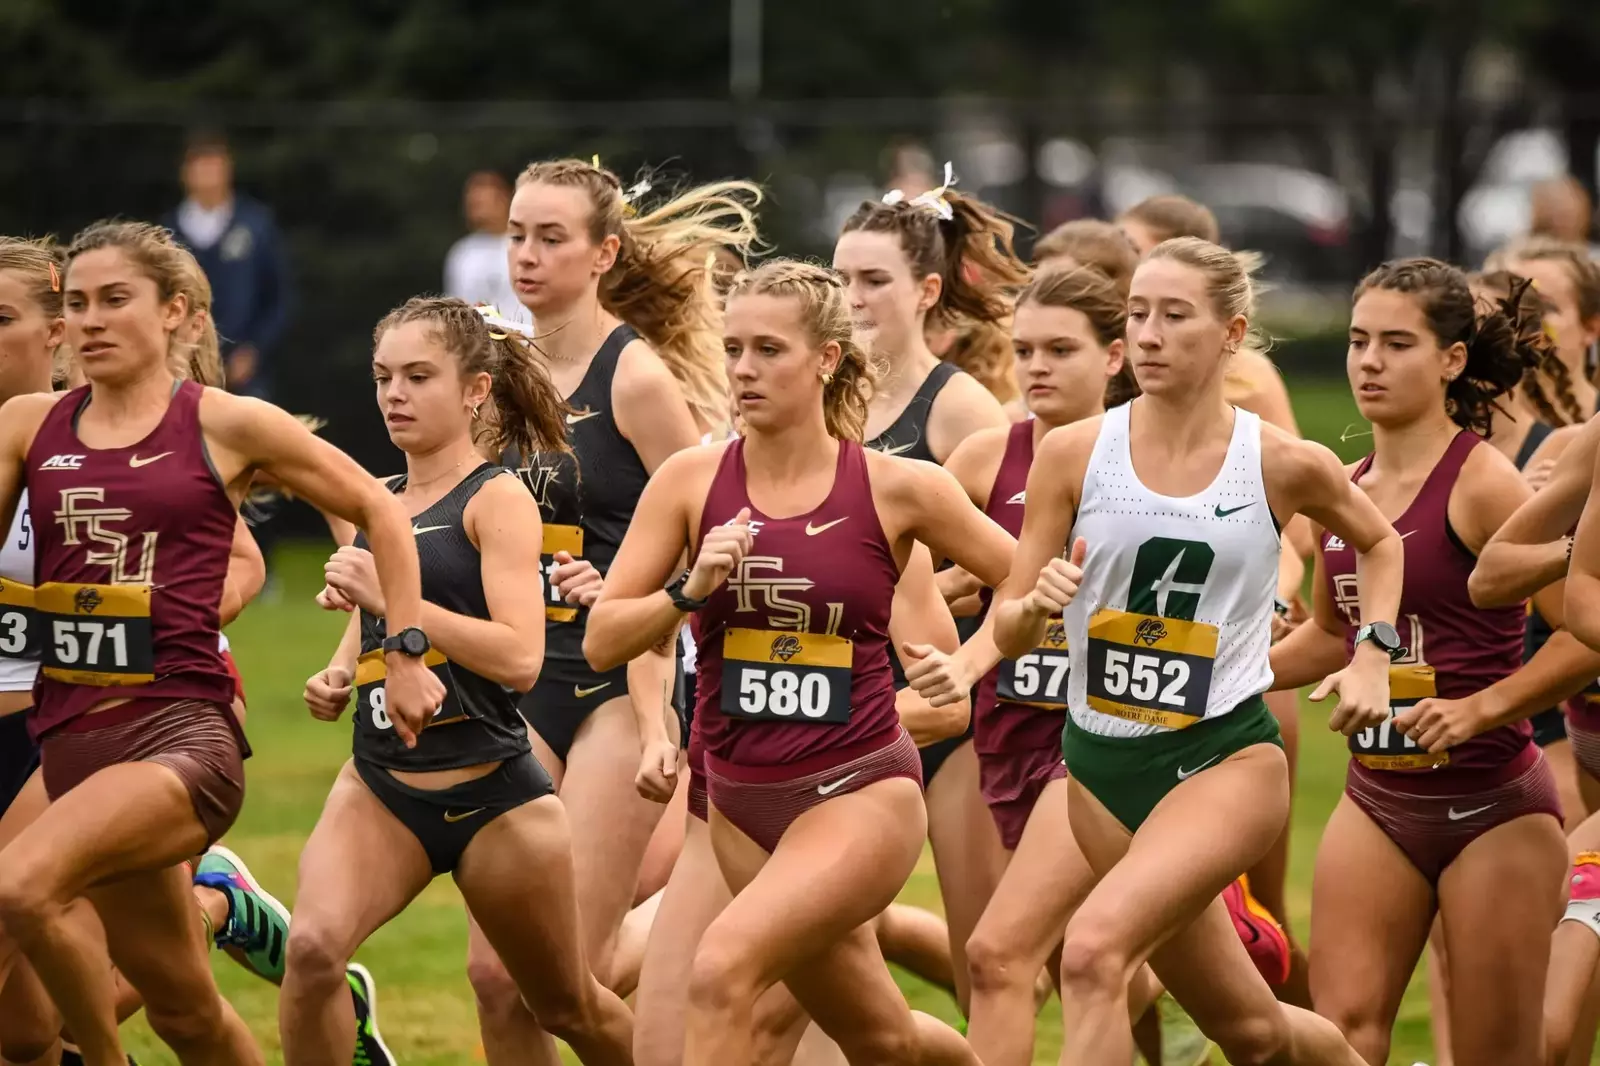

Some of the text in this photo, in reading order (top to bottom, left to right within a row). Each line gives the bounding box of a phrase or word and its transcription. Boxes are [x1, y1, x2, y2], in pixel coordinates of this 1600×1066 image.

[41, 454, 87, 467] ACC
[53, 487, 158, 586] FSU
[0, 611, 27, 653] 3
[53, 620, 128, 667] 571
[739, 668, 831, 718] 580
[1013, 653, 1069, 697] 57
[1103, 649, 1191, 707] 552
[1115, 708, 1169, 725] NOTRE DAME
